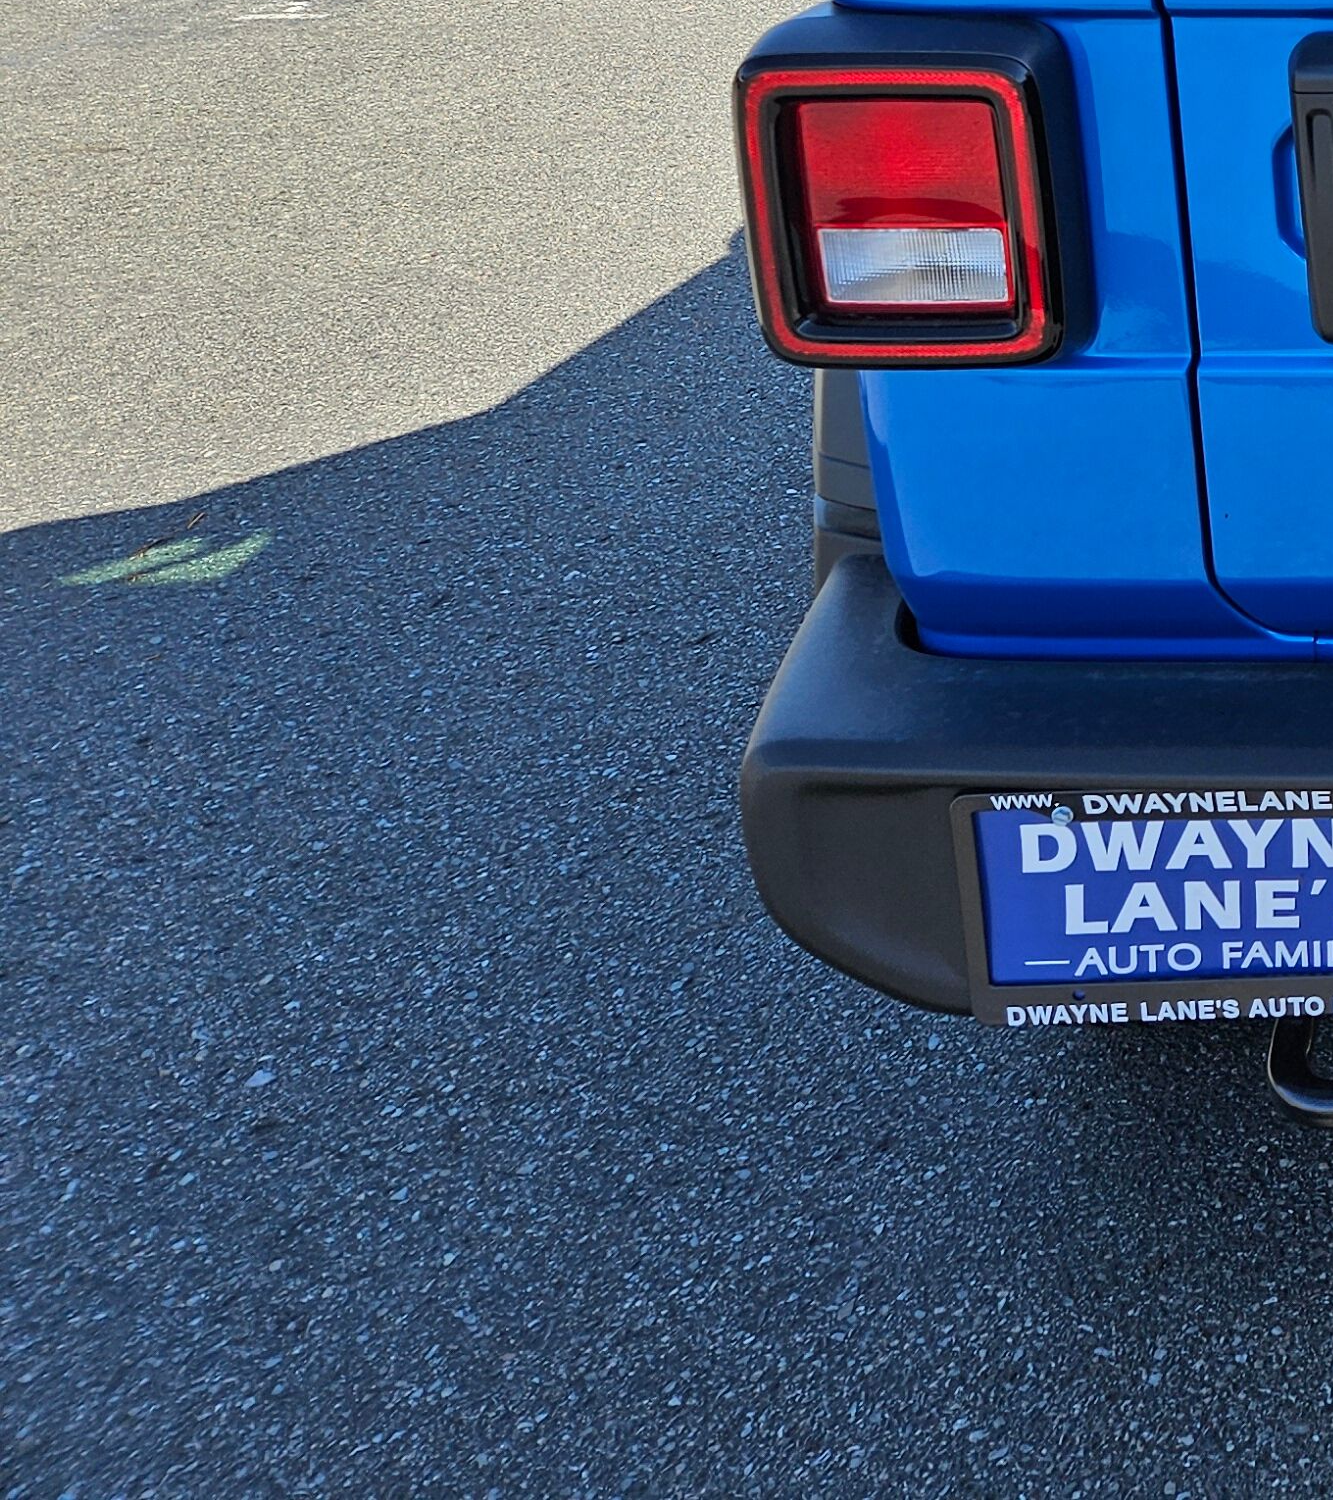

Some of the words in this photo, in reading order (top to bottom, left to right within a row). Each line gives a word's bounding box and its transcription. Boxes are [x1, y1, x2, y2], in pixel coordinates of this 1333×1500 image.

[1082, 790, 1333, 815] DWAYNELANE
[1074, 942, 1202, 977] AUTO
[1006, 1002, 1128, 1028] DWAYNE
[1140, 999, 1240, 1023] LANE'S
[1248, 996, 1325, 1019] AUTO
